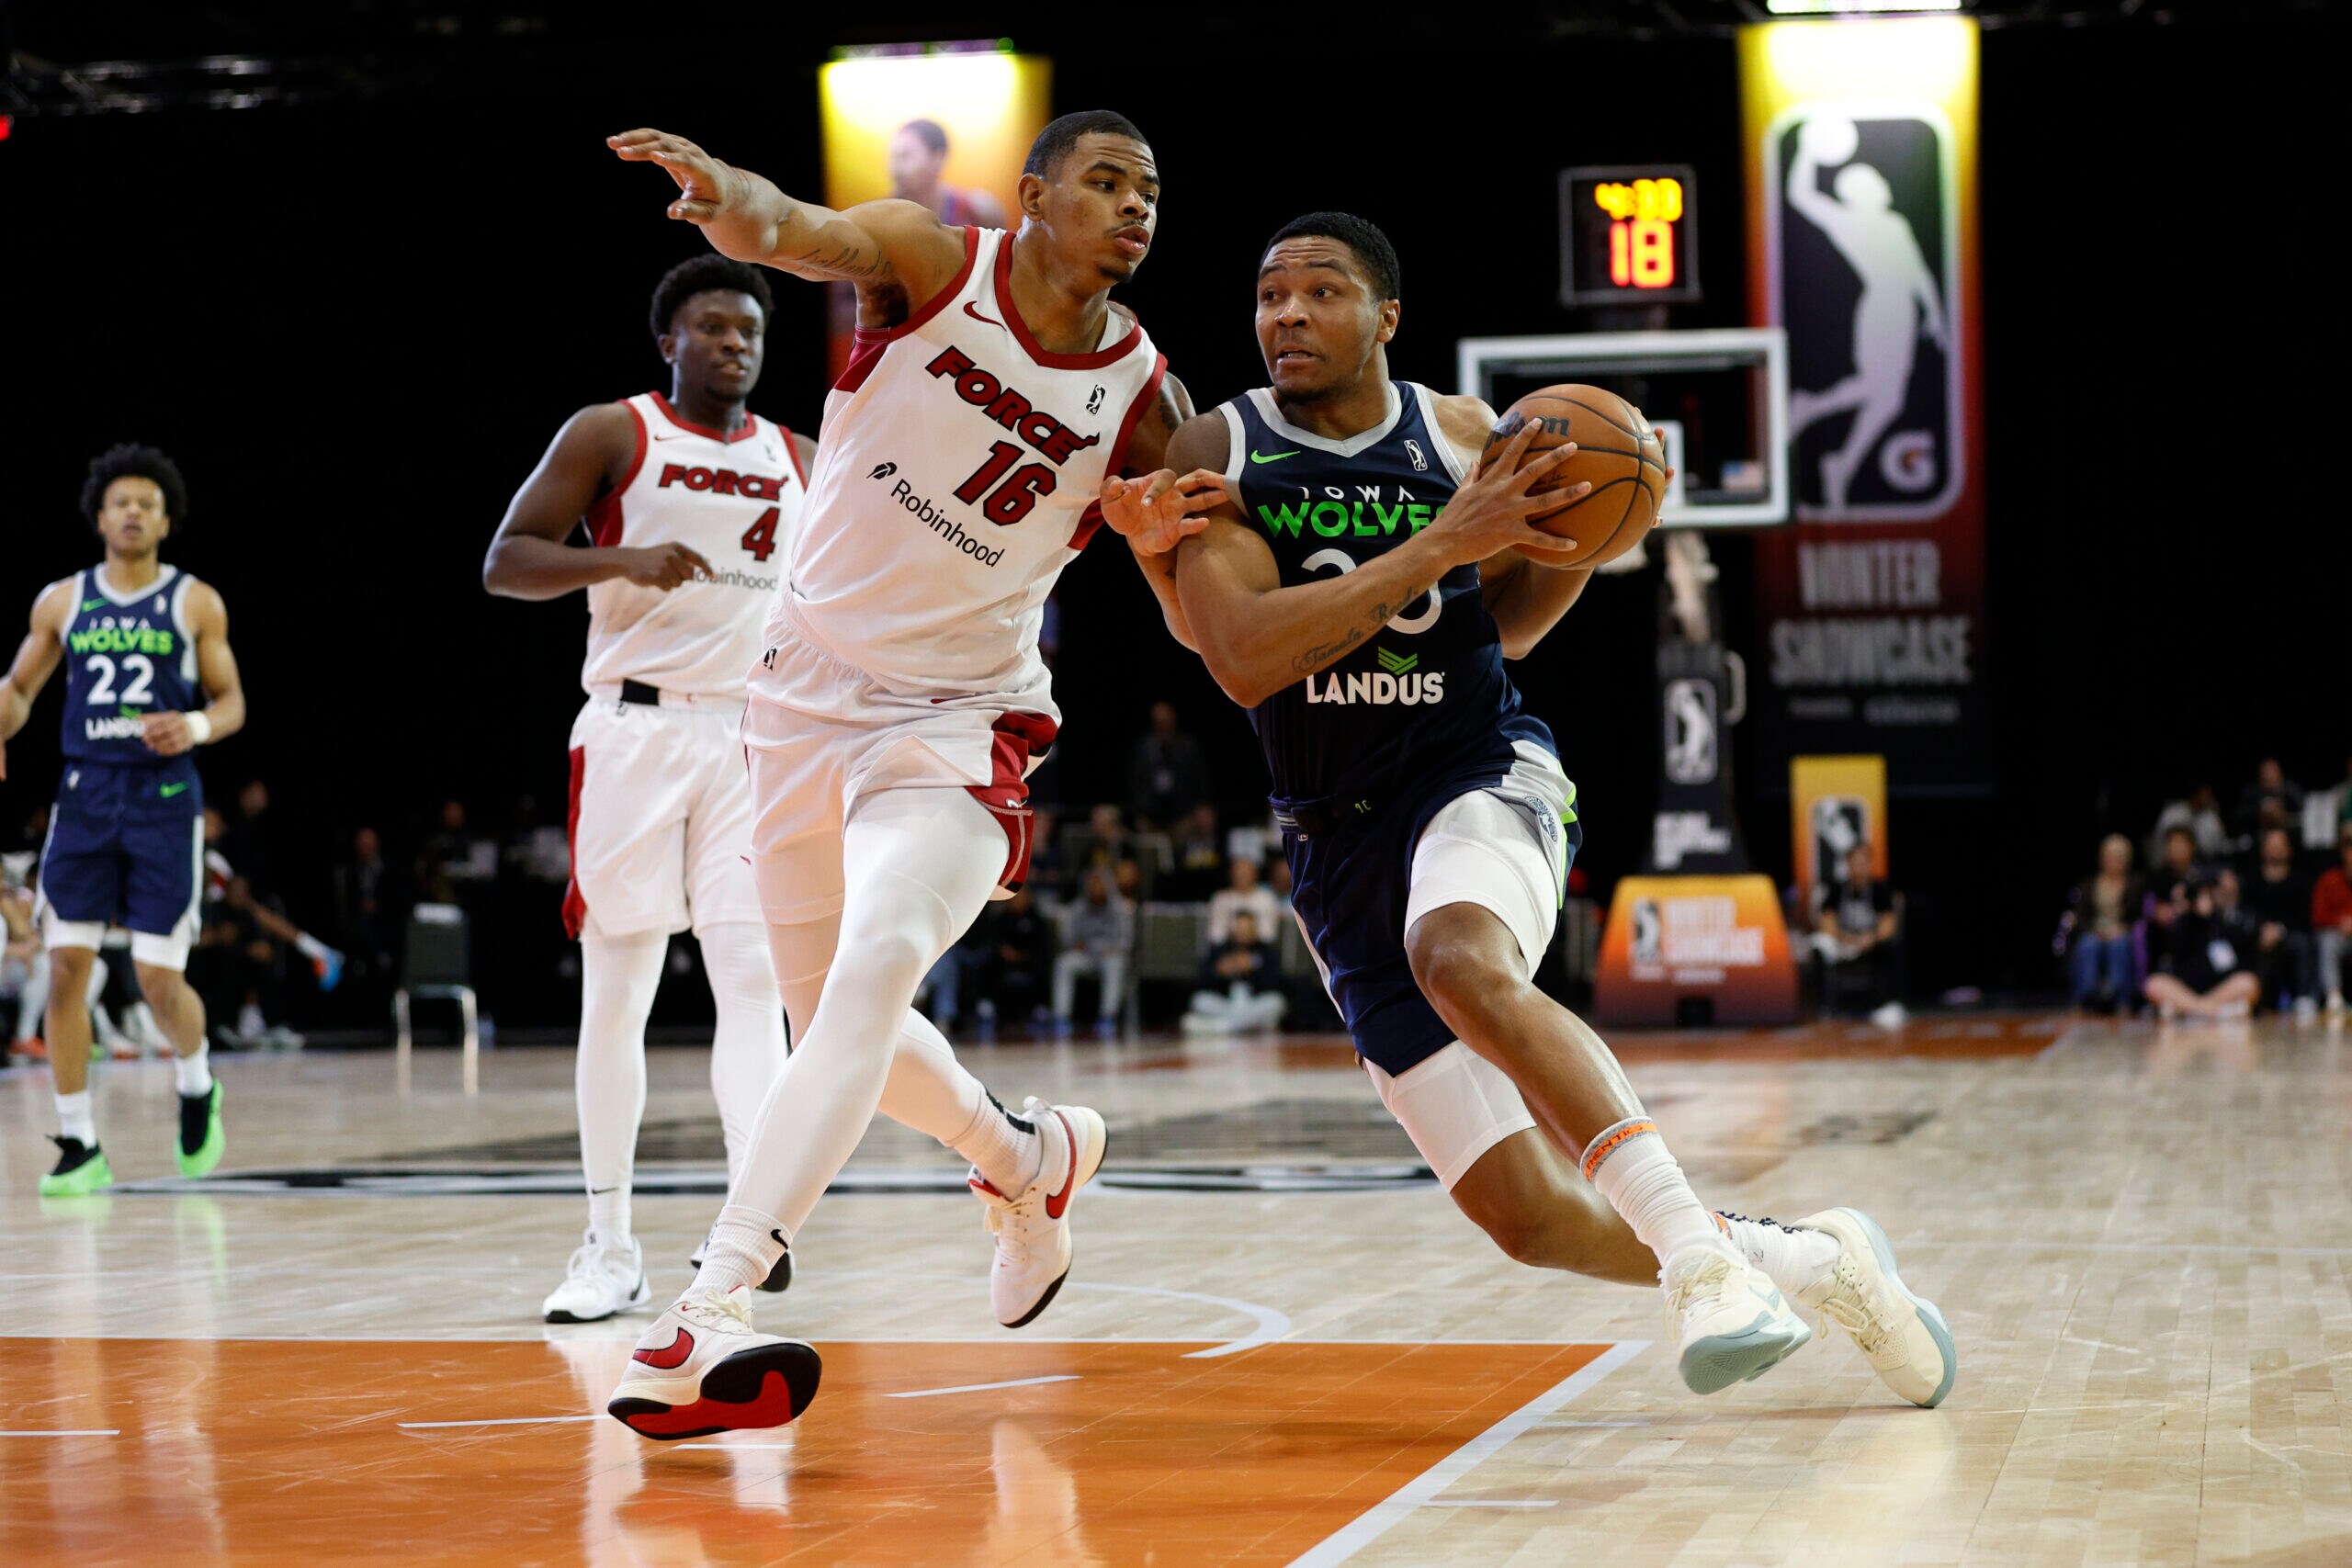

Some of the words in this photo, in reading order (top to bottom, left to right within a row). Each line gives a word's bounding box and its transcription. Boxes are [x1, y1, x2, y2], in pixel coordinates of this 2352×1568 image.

[1610, 220, 1674, 288] 18
[924, 344, 1100, 467] FORCE
[658, 463, 788, 502] FORCE
[952, 440, 1057, 527] 16
[1299, 485, 1416, 503] IOWA
[741, 506, 781, 562] 4
[890, 479, 1005, 568] Robinhood
[1256, 501, 1446, 539] WOLVE
[1798, 539, 1940, 610] WINTER
[70, 628, 174, 655] WOLVES
[89, 615, 151, 631] IOWA
[1770, 616, 1971, 686] SHOWCASE
[85, 653, 154, 705] 22
[1306, 671, 1446, 706] LANDUS
